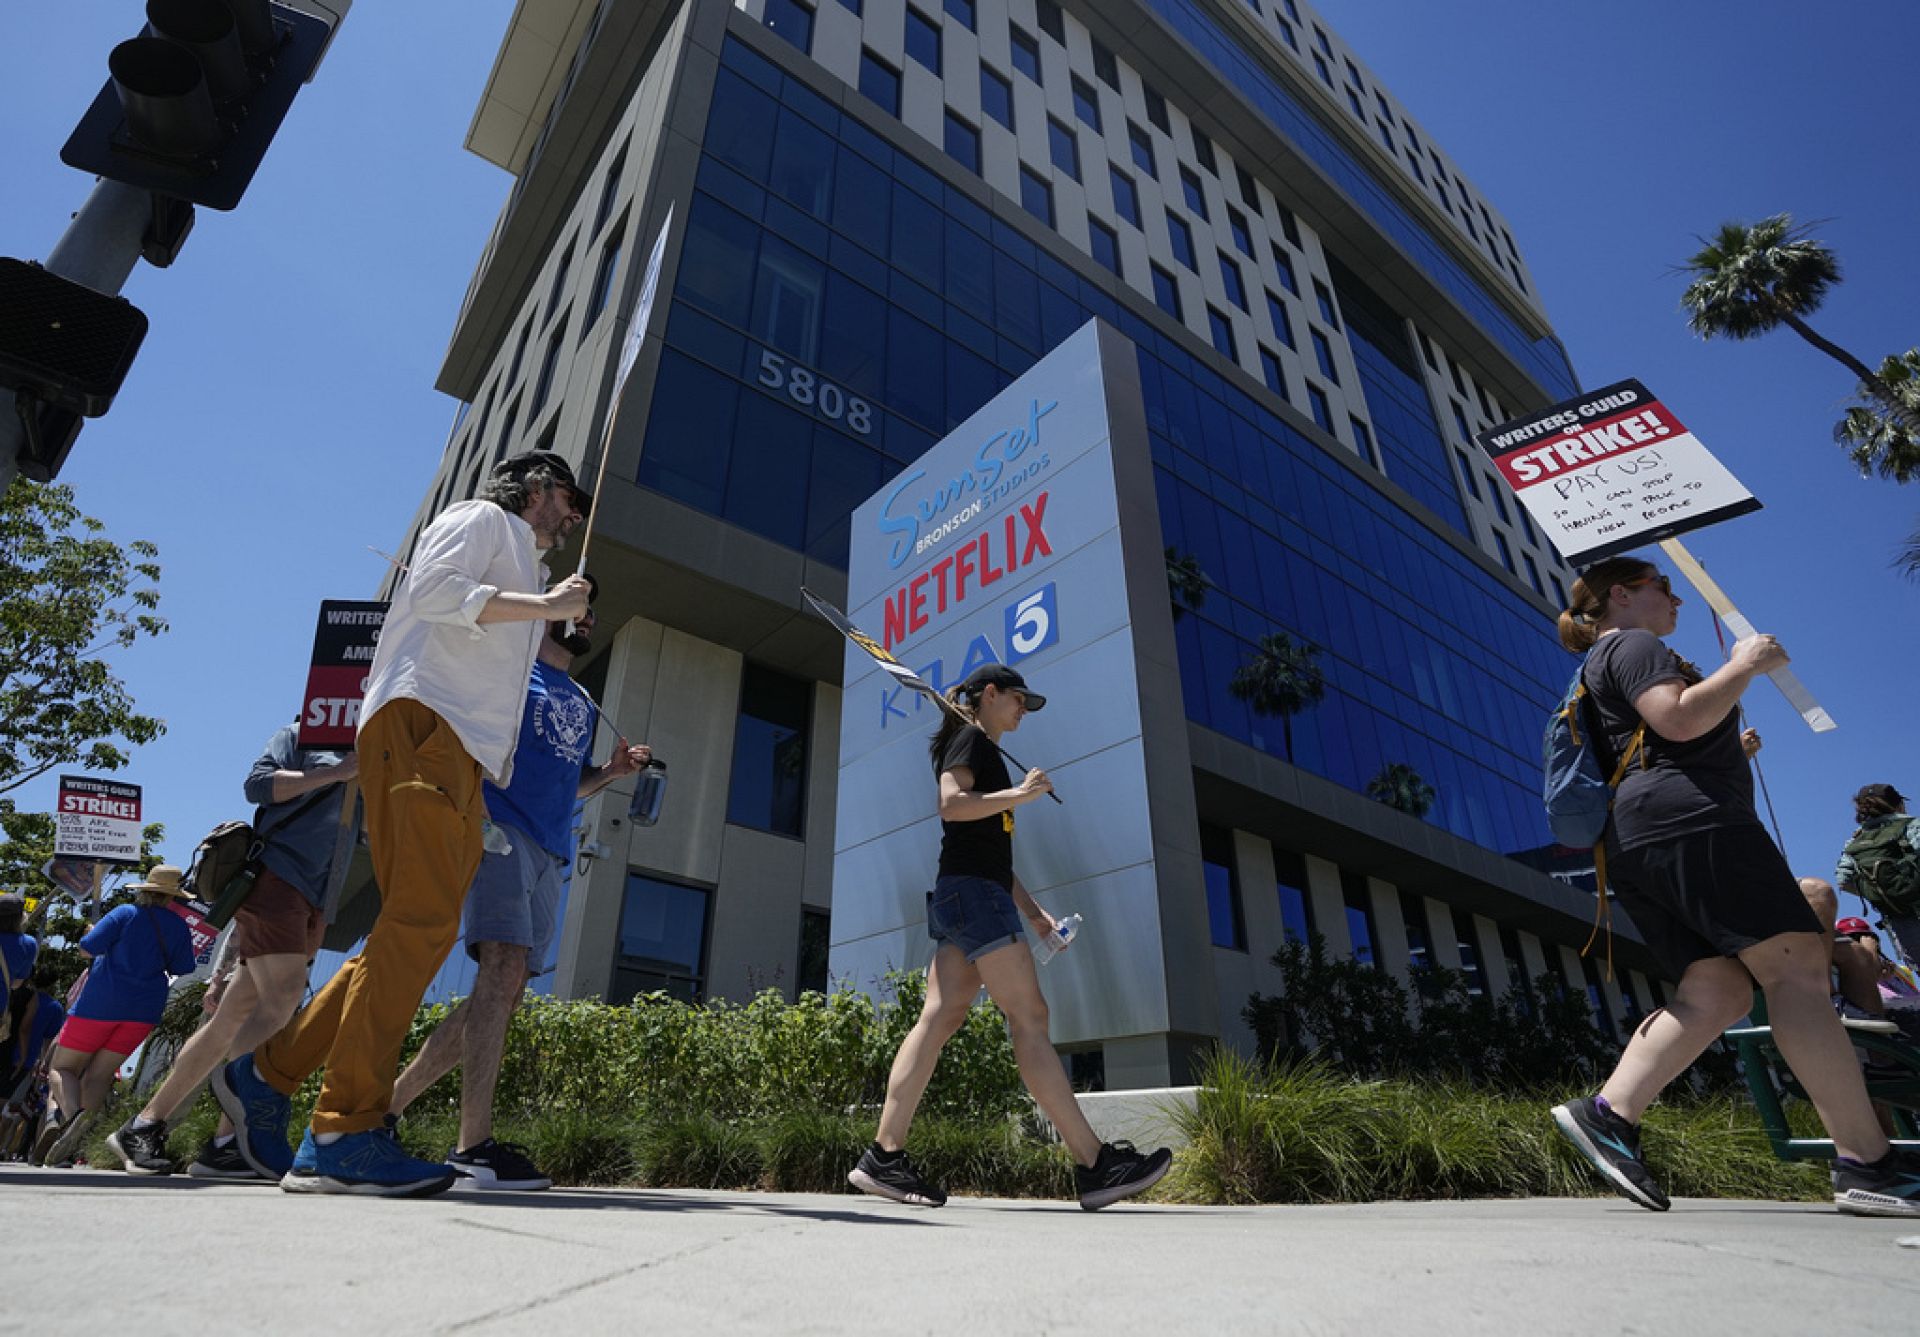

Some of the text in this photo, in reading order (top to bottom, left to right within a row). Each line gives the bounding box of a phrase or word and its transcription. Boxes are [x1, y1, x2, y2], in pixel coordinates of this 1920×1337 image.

[758, 349, 871, 434] 5808
[1490, 389, 1638, 450] WRITERS GUILD
[1509, 410, 1670, 483] STRIKE!
[1562, 423, 1584, 436] ON
[916, 453, 1051, 555] BRONSON STUDIOS
[1553, 449, 1668, 500] PAY US!
[882, 491, 1054, 652] NETFLIX
[1012, 590, 1049, 654] 5
[306, 697, 362, 727] STR
[63, 795, 136, 819] STRIKE!
